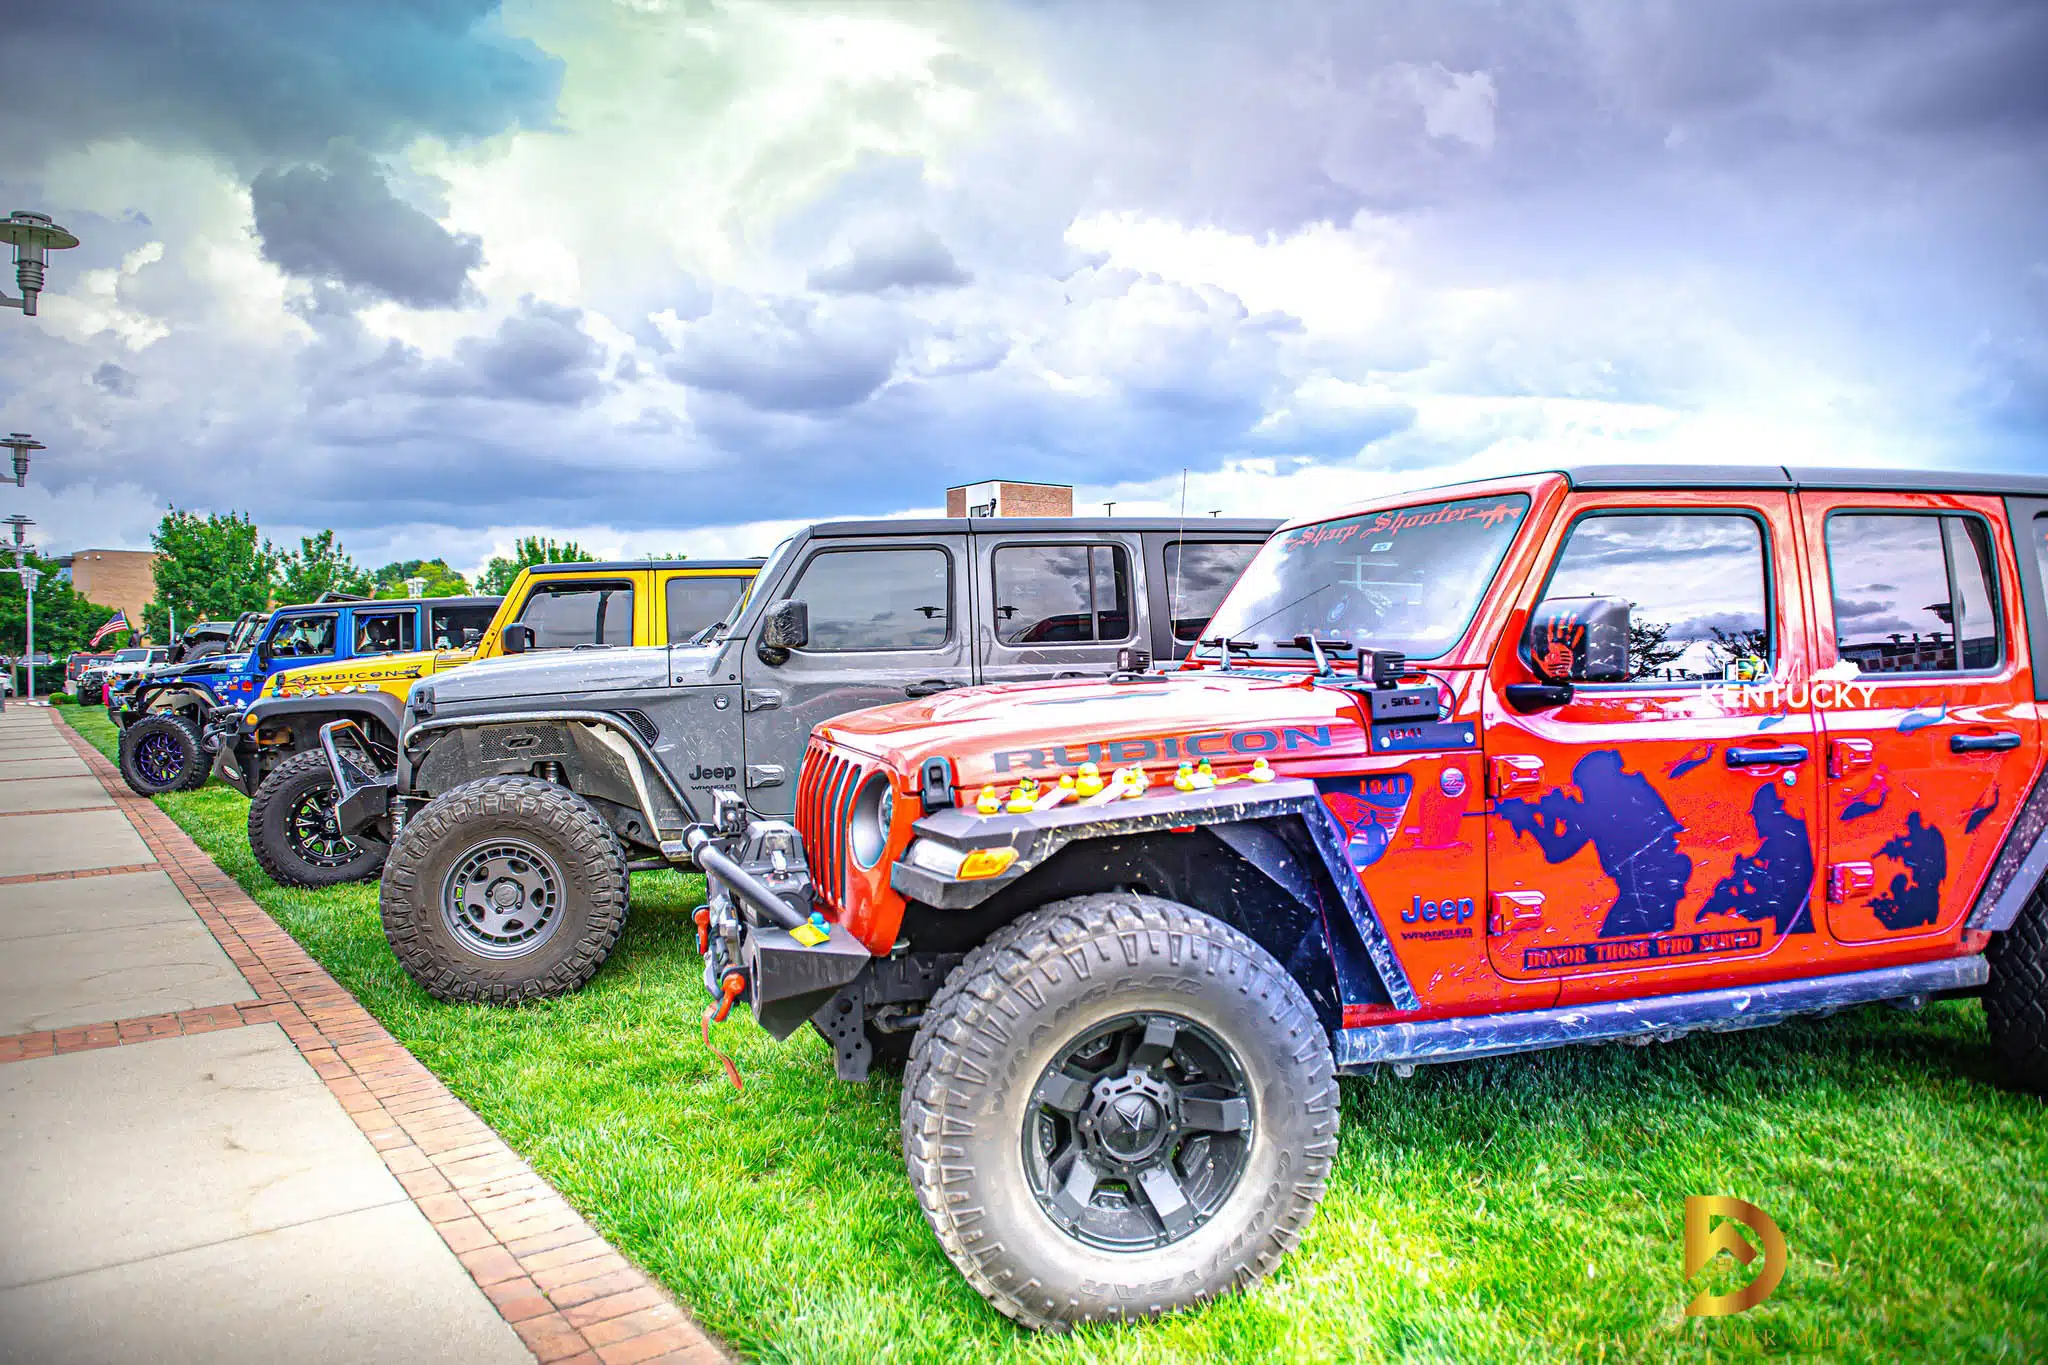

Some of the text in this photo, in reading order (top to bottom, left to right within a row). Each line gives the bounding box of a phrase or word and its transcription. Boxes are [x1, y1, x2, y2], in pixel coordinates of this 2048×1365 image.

[1286, 503, 1476, 551] Sharp Shooter
[309, 669, 399, 682] RUBICON
[994, 726, 1332, 773] RUBICON
[688, 764, 737, 781] Jeep
[1359, 777, 1406, 796] 1941
[1400, 895, 1475, 924] Jeep
[1400, 927, 1474, 941] WRANGLER
[1526, 930, 1760, 968] HONOR THOSE WHO SERVED
